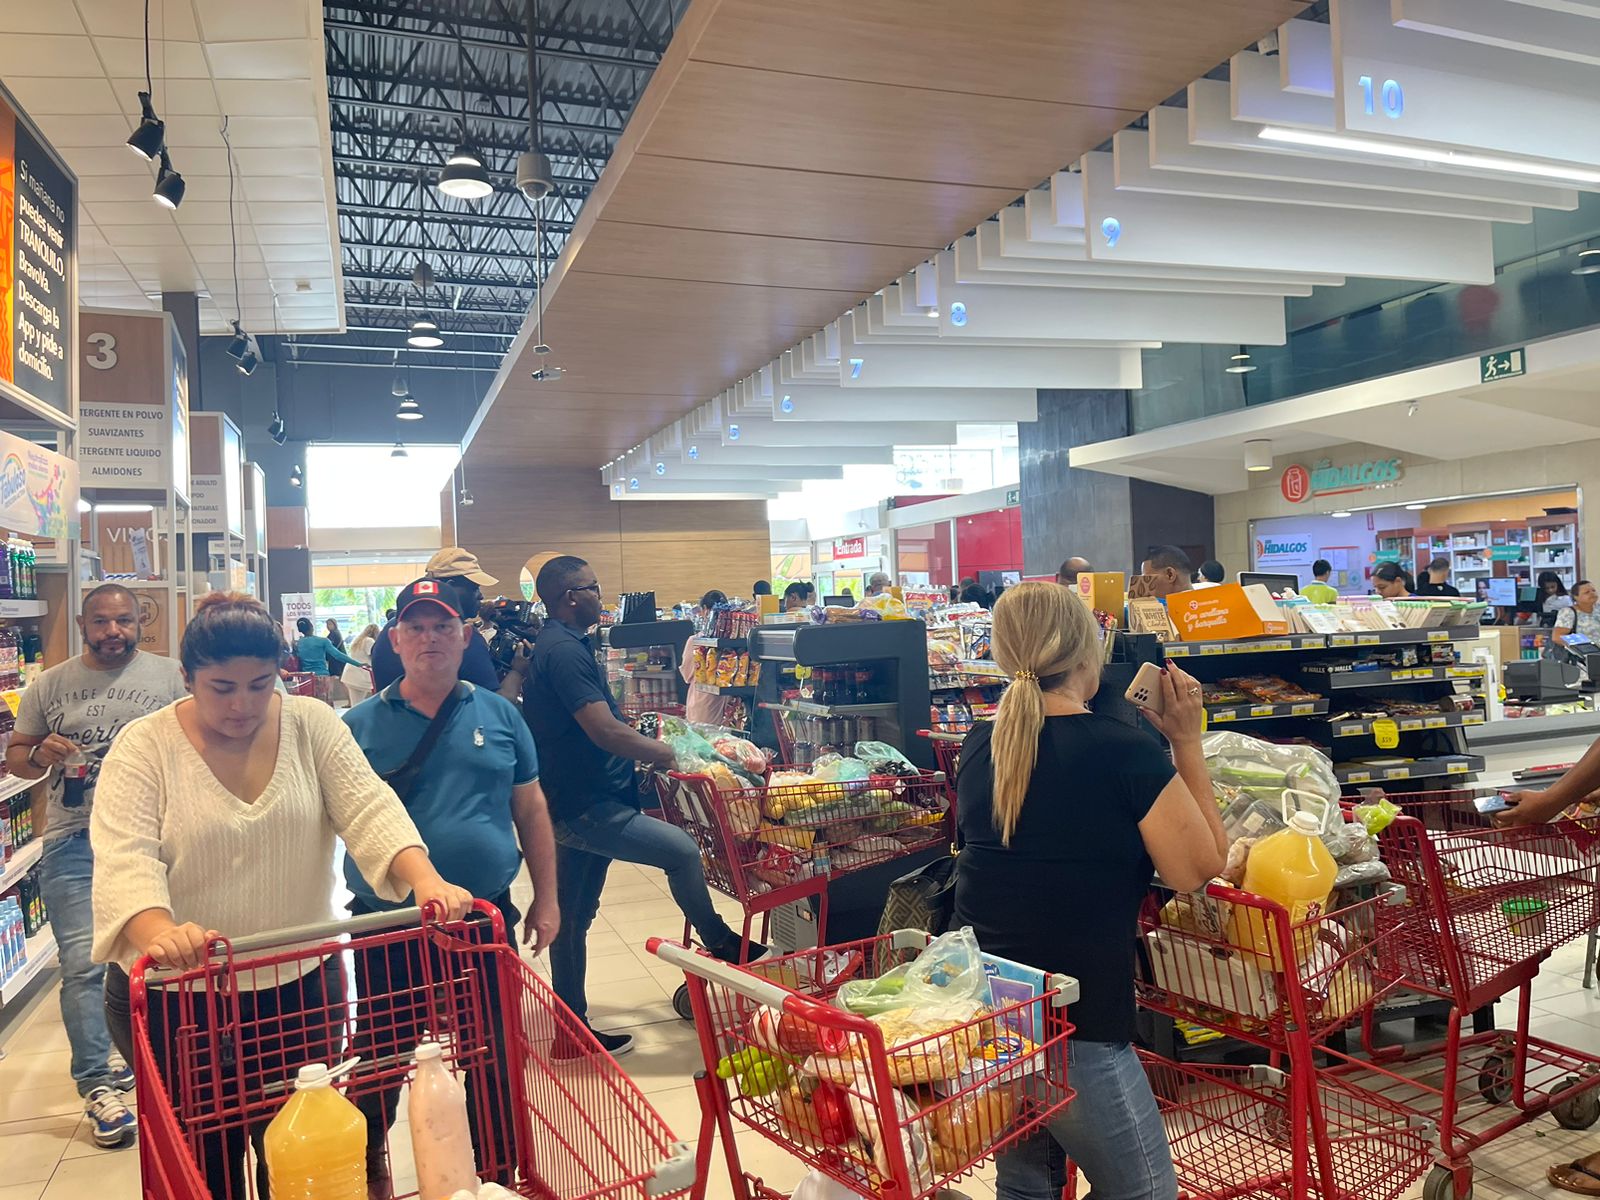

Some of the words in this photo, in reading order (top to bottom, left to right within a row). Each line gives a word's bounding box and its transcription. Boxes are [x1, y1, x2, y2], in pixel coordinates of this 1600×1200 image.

[1358, 76, 1404, 118] 10
[20, 160, 28, 182] Si
[29, 174, 55, 214] mañana
[56, 206, 65, 223] no
[20, 194, 46, 232] puedes
[47, 222, 64, 249] venir
[1102, 217, 1120, 247] 9
[19, 218, 65, 282] TRANQUILO,
[19, 279, 52, 326] Descarga
[53, 306, 60, 330] la
[951, 302, 967, 327] 8
[18, 311, 35, 344] App
[36, 328, 42, 348] y
[42, 331, 57, 356] pide
[58, 344, 64, 360] a
[86, 332, 117, 370] 3
[18, 341, 53, 381] domicilio.
[849, 358, 864, 379] 7
[781, 395, 794, 413] 6
[80, 408, 120, 419] TERGENTE
[122, 410, 133, 419] EN
[136, 410, 163, 420] POLVO
[88, 427, 144, 438] SUAVIZANTES
[729, 424, 740, 440] 5
[80, 446, 124, 457] ETERGENTE
[126, 448, 161, 458] LIQUIDO
[688, 446, 698, 459] 4
[92, 467, 142, 477] ALMIDONES
[656, 463, 665, 475] 3
[1311, 457, 1401, 489] HIDALGOS
[615, 486, 621, 496] 1
[630, 478, 639, 489] 2
[106, 527, 170, 543] VIO
[1264, 542, 1307, 554] HIDALGOS
[286, 602, 312, 611] TODOS
[1143, 612, 1165, 620] WHITE
[107, 687, 164, 712] QUALIT
[86, 705, 107, 717] EST
